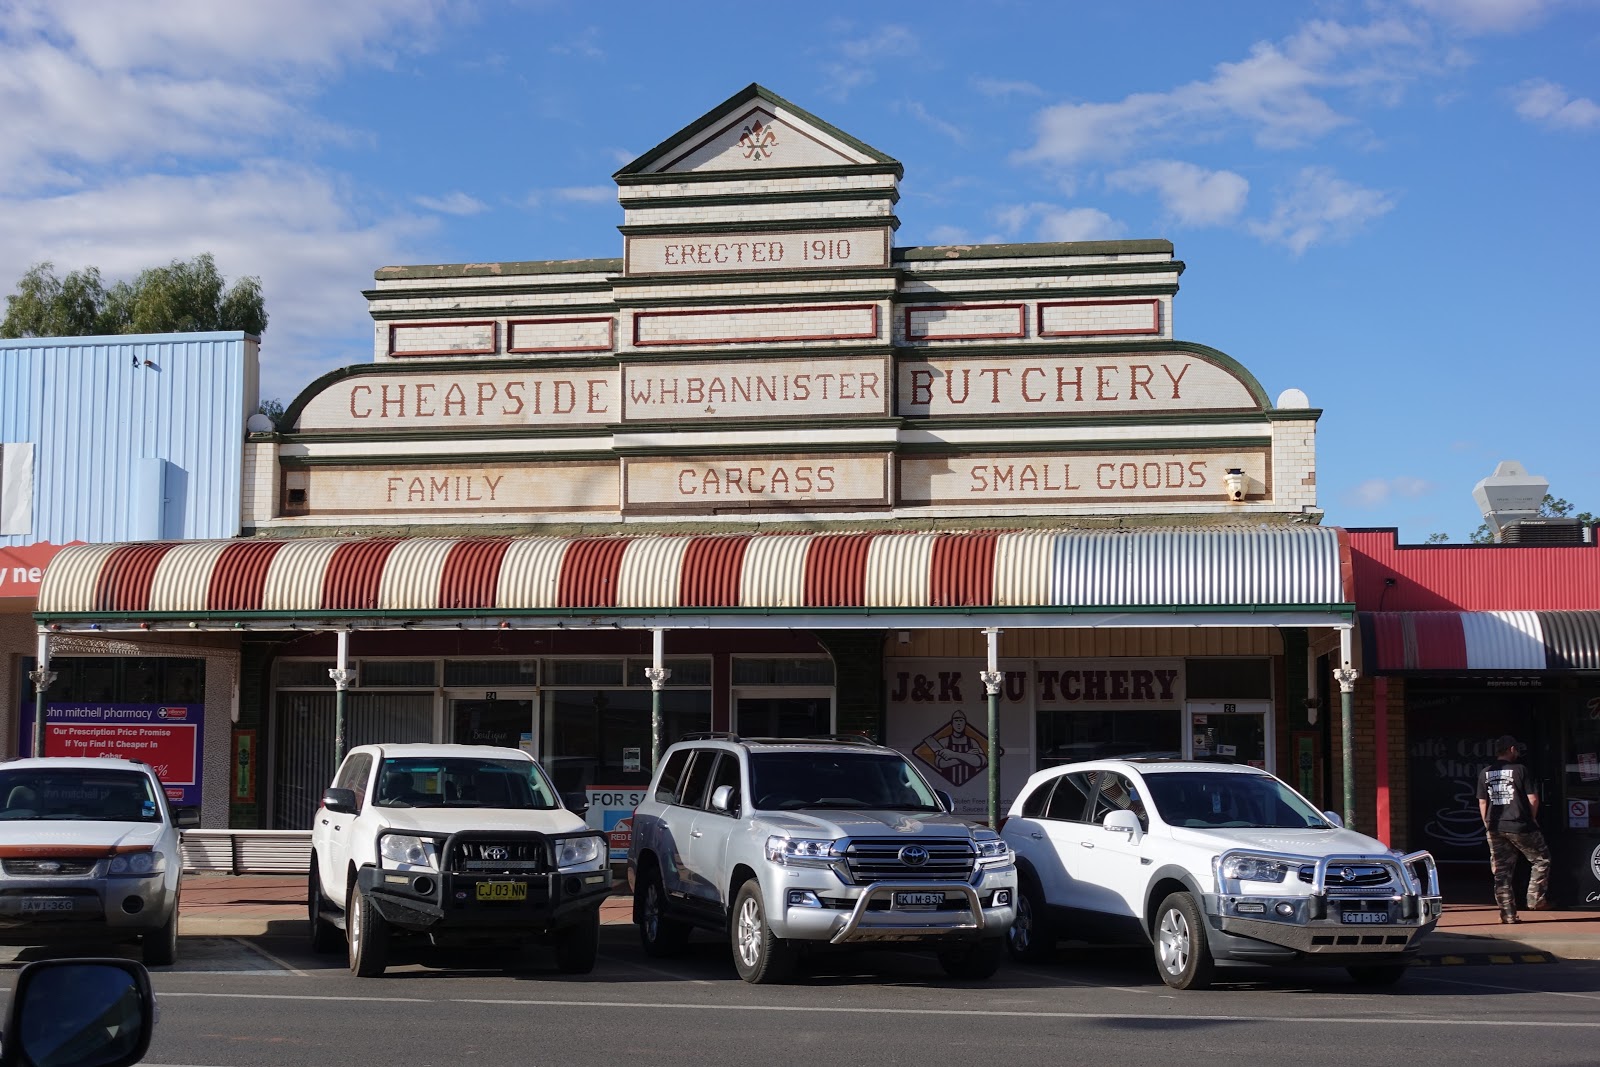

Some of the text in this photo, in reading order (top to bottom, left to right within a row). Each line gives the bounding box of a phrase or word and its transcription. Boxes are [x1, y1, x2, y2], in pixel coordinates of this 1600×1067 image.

[665, 240, 851, 265] ERECTED 1910
[910, 363, 1191, 405] BUTCHERY
[350, 379, 608, 418] CHEAPSIDE
[387, 475, 504, 502] FAMILY
[678, 466, 835, 495] CARCASS
[970, 461, 1208, 492] SMALL GOODS
[891, 671, 963, 702] J&K
[46, 707, 153, 720] ohn mitchell pharmacy
[1225, 704, 1235, 712] 26
[69, 728, 115, 737] Prescription
[117, 728, 137, 736] Price
[139, 729, 171, 737] Promise
[89, 740, 106, 748] Find
[116, 741, 148, 749] Cheaper
[592, 793, 624, 806] FOR
